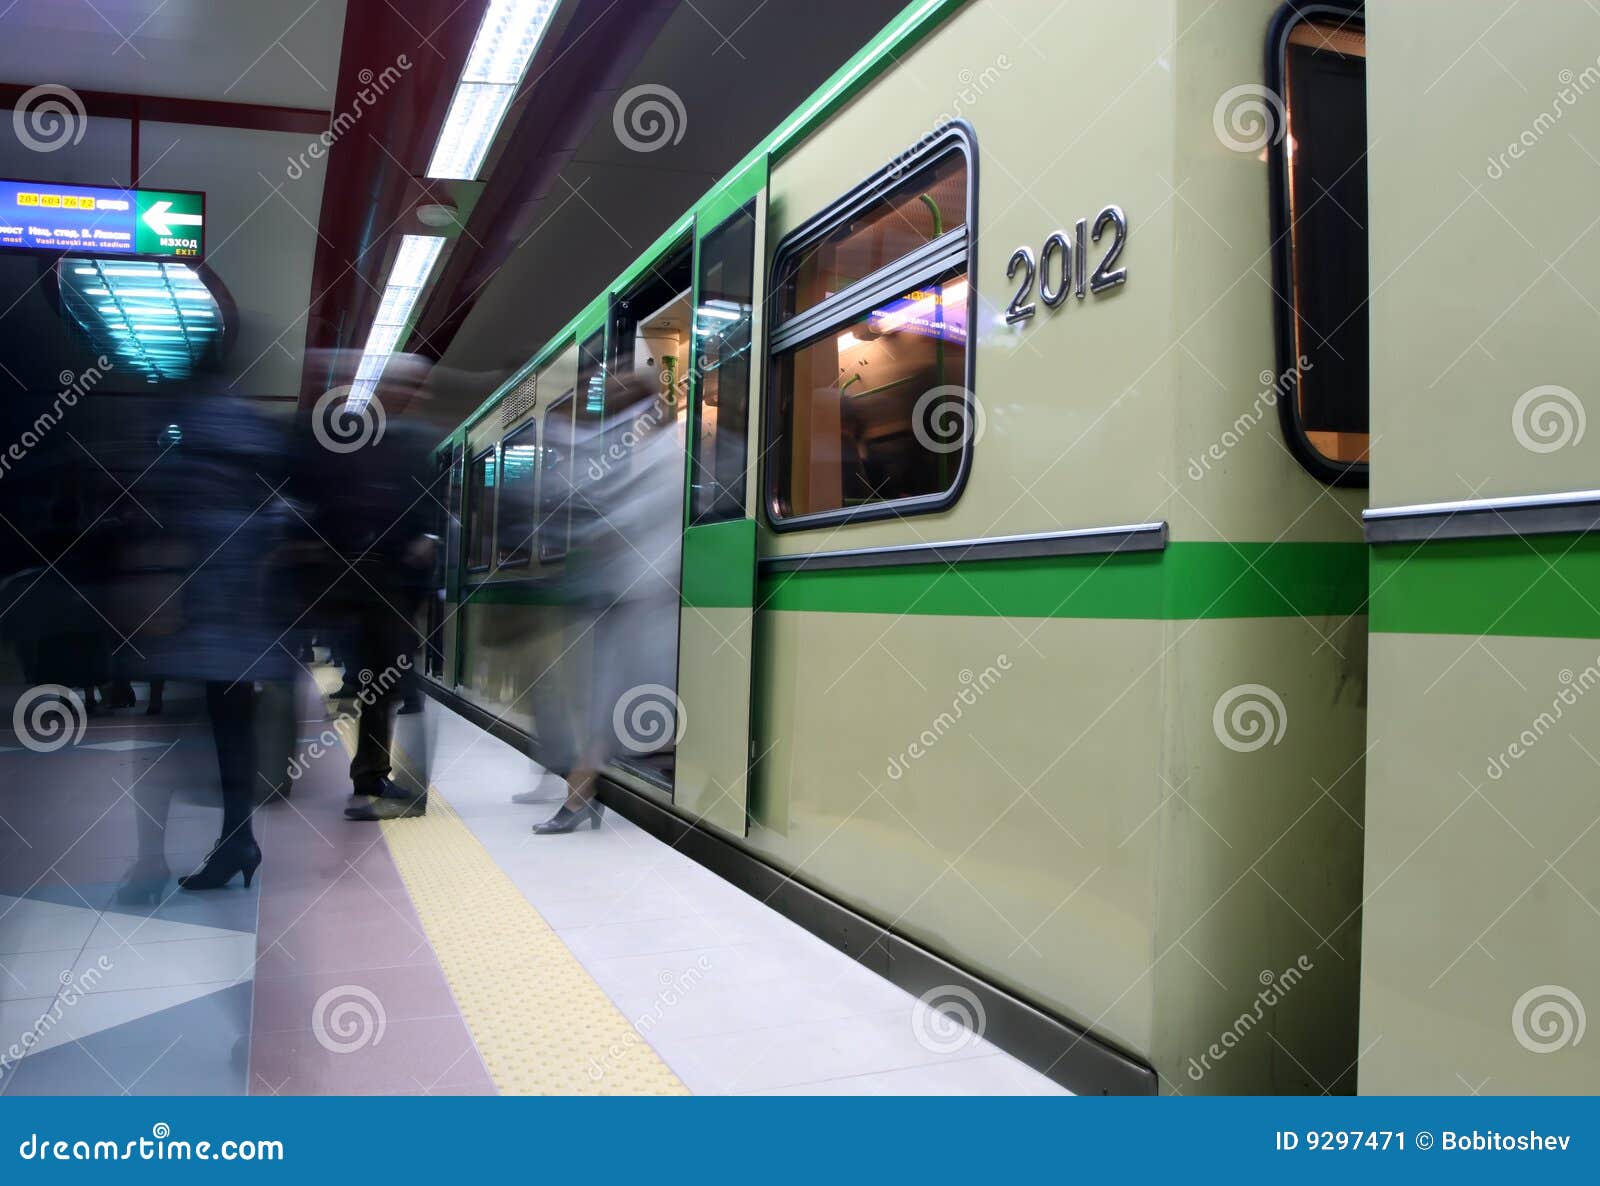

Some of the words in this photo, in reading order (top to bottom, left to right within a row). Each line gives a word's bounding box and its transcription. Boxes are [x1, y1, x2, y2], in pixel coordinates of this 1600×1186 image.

[36, 237, 55, 245] Vasil
[56, 238, 81, 246] Levski
[100, 241, 130, 249] stadium
[175, 248, 197, 256] EXIT
[1006, 204, 1127, 325] 2012
